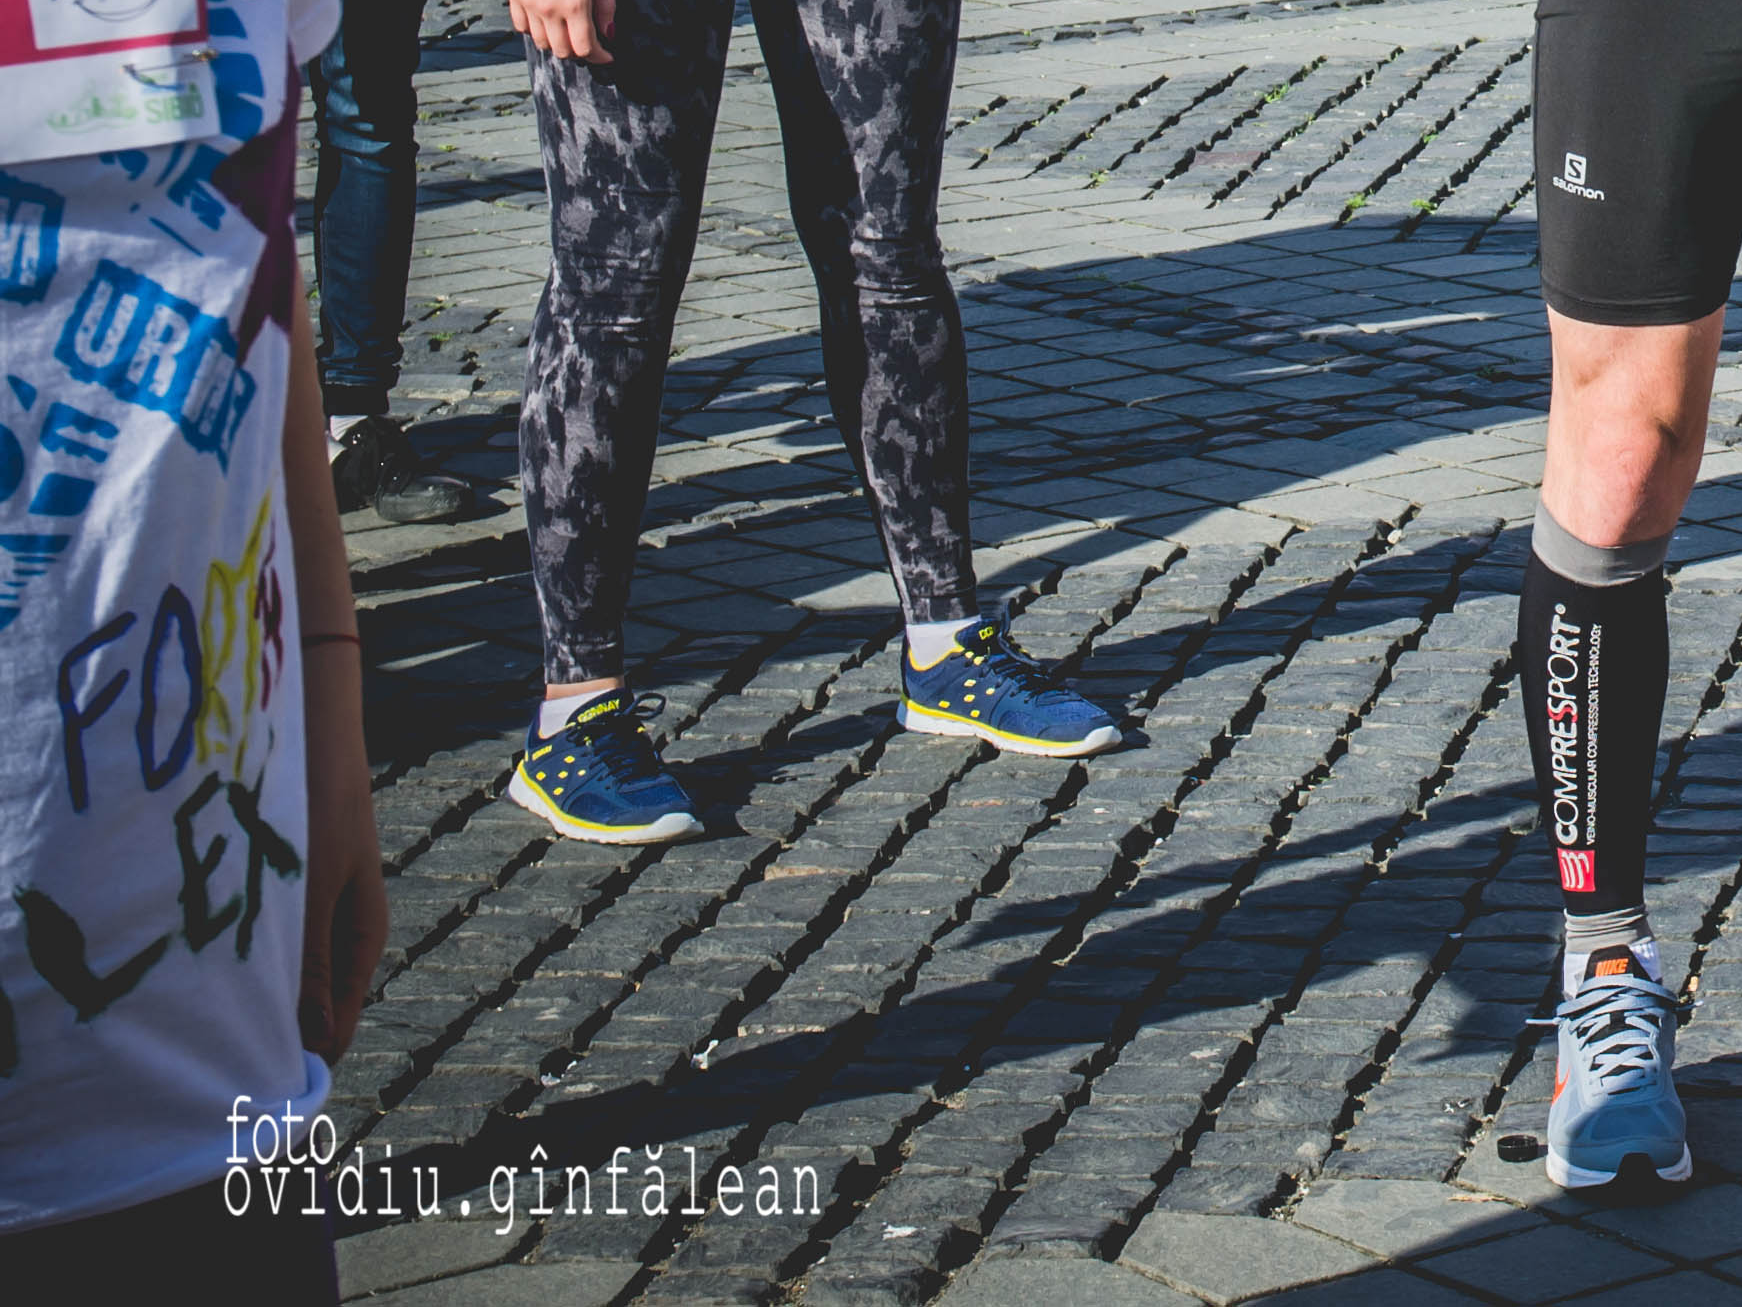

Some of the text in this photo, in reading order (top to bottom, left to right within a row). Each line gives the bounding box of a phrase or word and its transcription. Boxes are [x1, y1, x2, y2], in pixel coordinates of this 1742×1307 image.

[1553, 176, 1605, 201] salomon
[1588, 624, 1602, 689] TECHNOLOGY
[1587, 690, 1600, 759] COMPRESSION
[1595, 958, 1629, 977] NIKE
